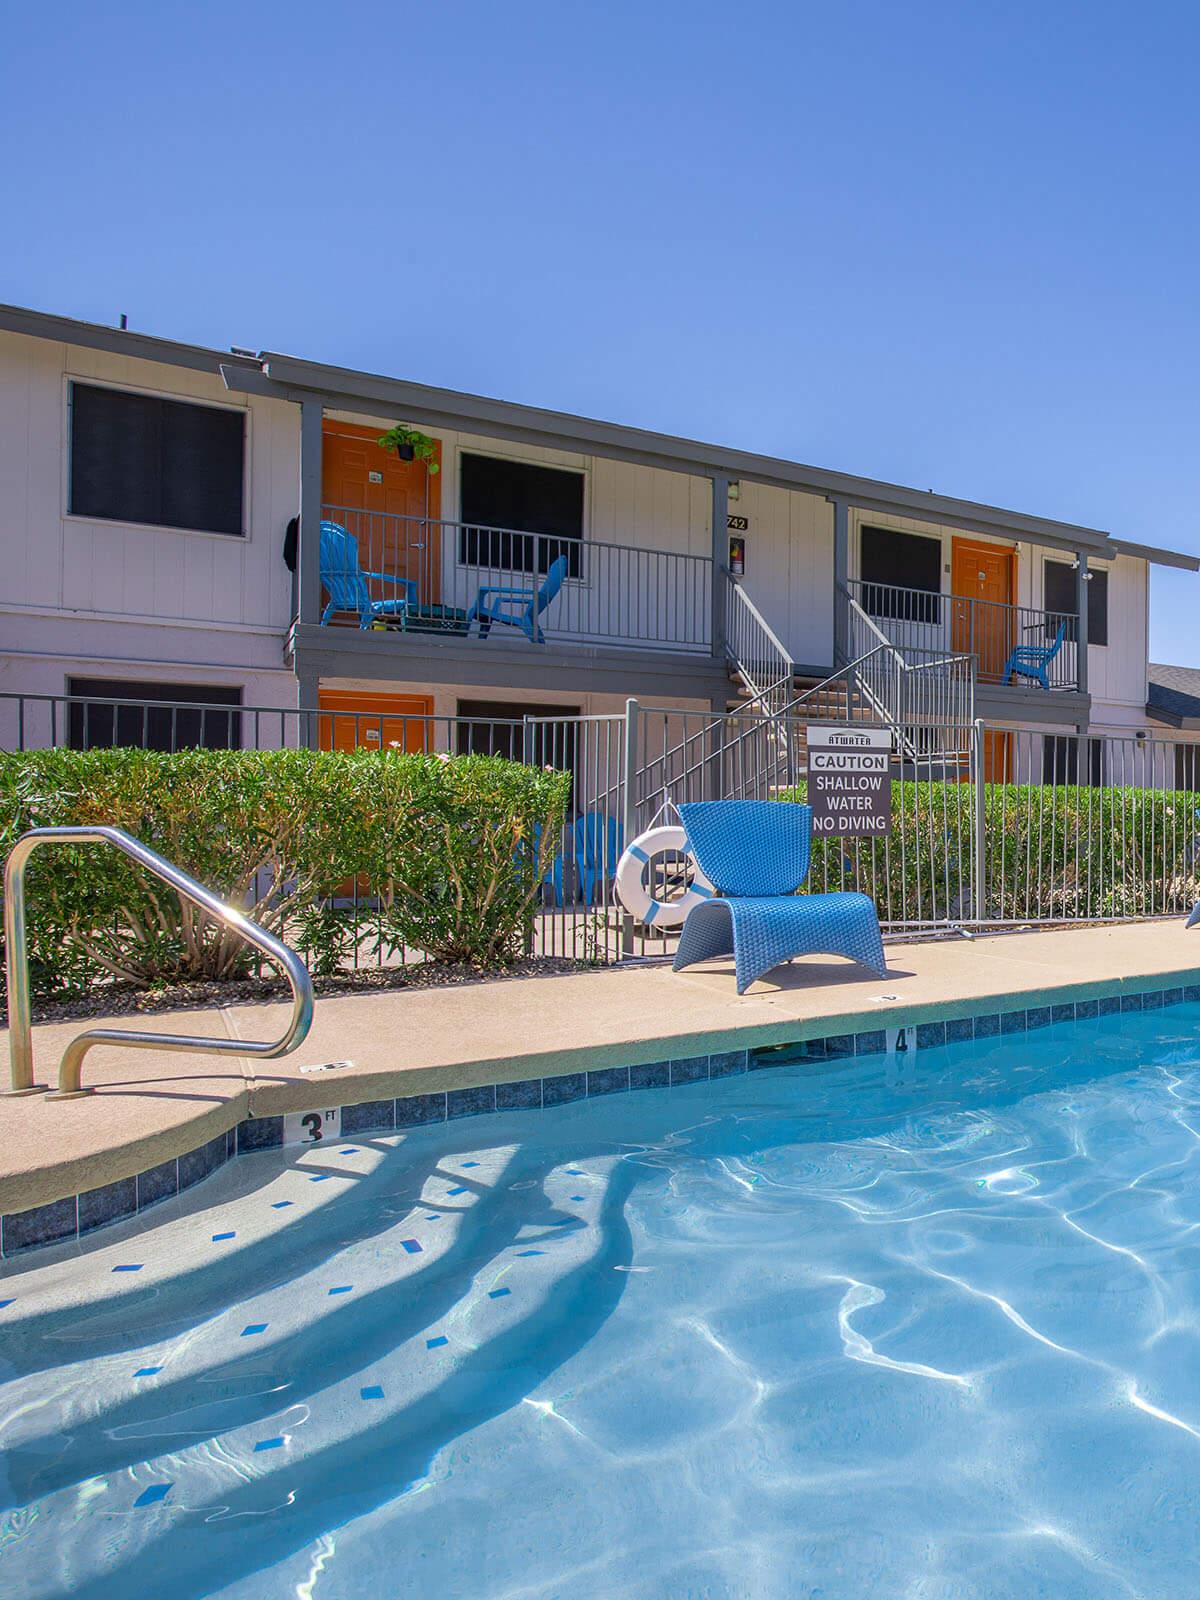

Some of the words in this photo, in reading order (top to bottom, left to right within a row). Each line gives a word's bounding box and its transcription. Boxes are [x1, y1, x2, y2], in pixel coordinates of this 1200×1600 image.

[828, 736, 872, 746] ATWATER
[815, 756, 884, 769] CAUTION
[816, 776, 882, 790] SHALLOW
[826, 797, 873, 810] WATER
[813, 817, 835, 831] NO
[838, 816, 886, 830] DIVING
[896, 1028, 908, 1051] 4
[301, 1113, 323, 1143] 3
[325, 1110, 336, 1121] FT
